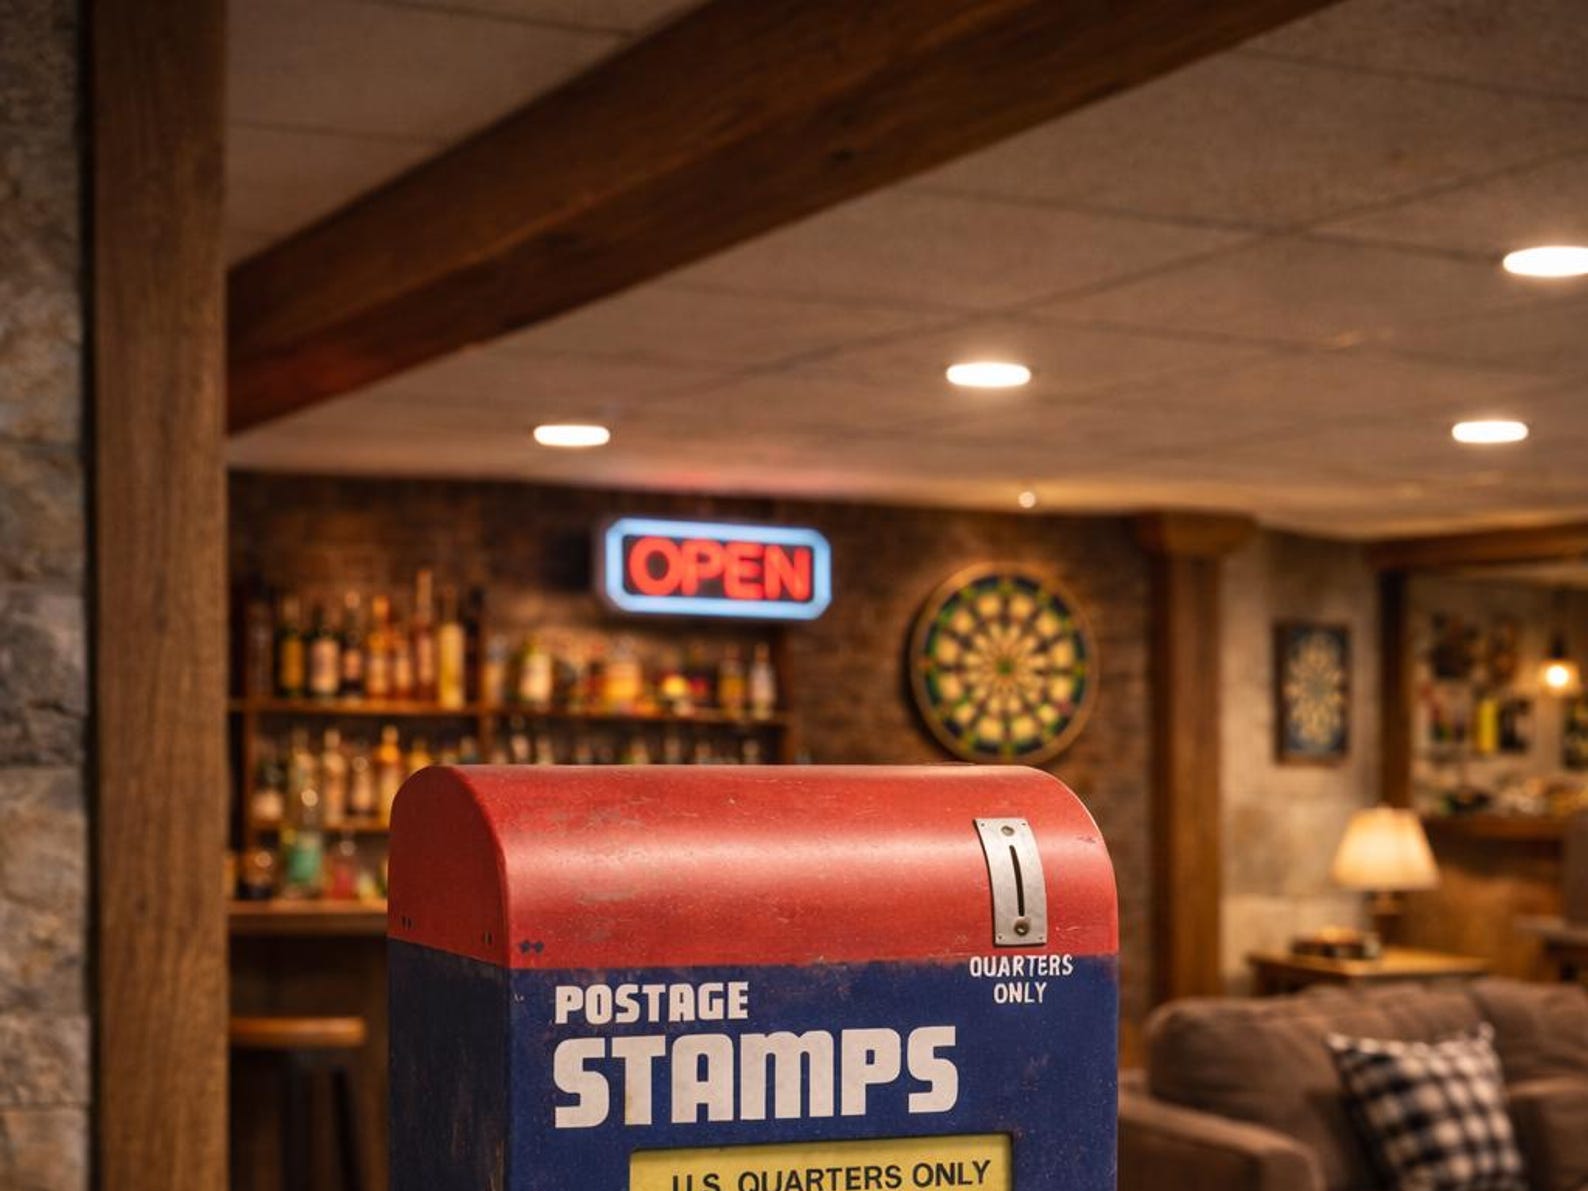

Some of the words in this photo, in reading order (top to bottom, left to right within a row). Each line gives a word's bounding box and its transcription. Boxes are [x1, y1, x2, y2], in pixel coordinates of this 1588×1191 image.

[628, 535, 812, 602] OPEN
[968, 954, 1073, 979] QUARTERS
[554, 980, 749, 1025] POSTAGE
[993, 982, 1048, 1005] ONLY
[553, 1025, 959, 1129] STAMPS
[912, 1159, 991, 1188] ONLY
